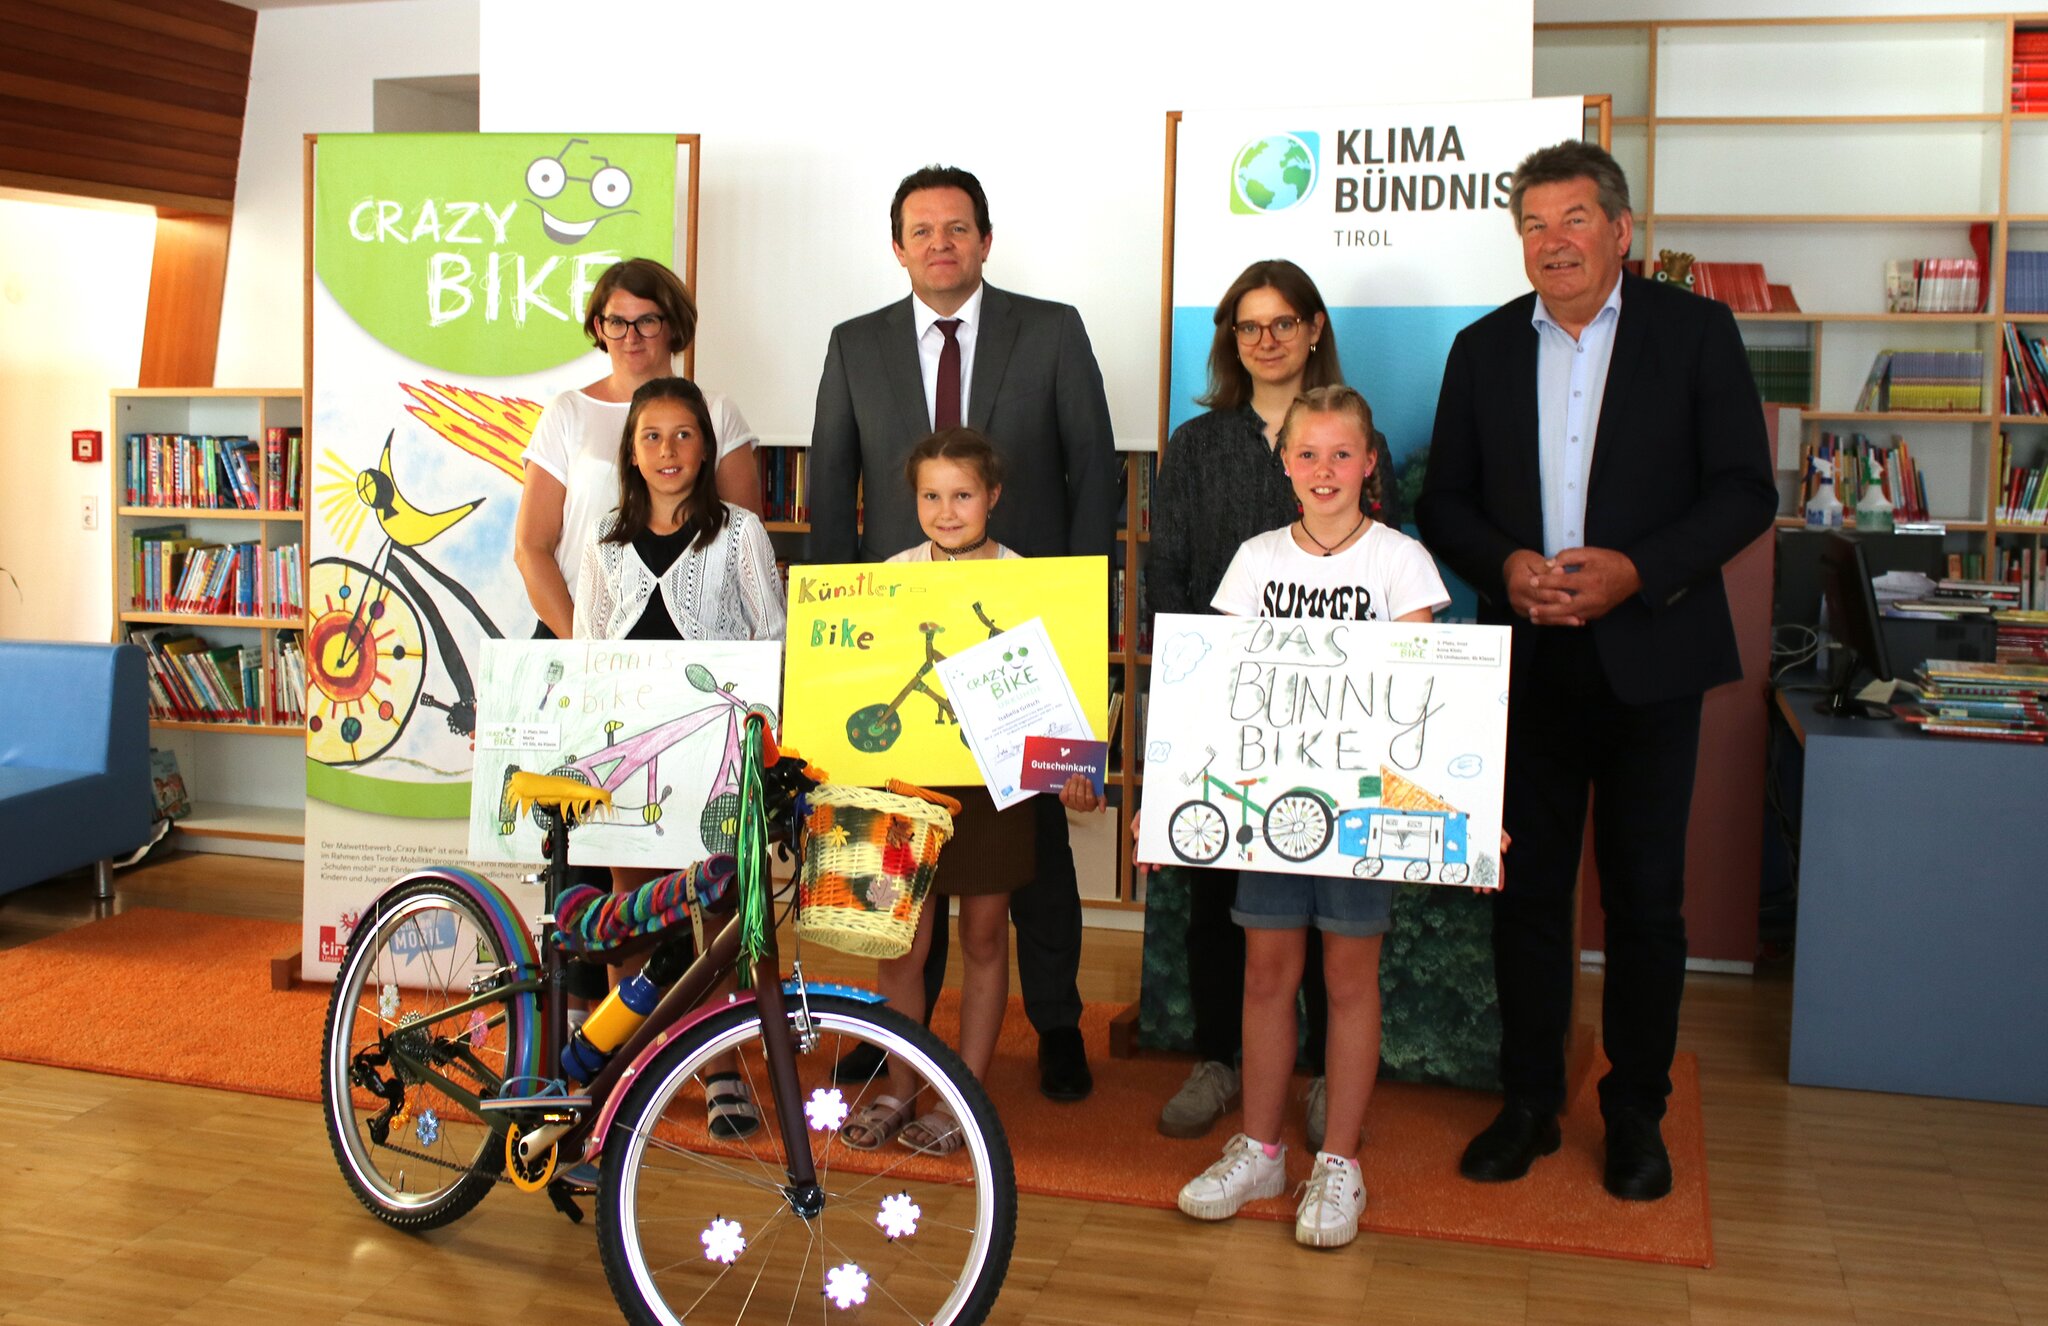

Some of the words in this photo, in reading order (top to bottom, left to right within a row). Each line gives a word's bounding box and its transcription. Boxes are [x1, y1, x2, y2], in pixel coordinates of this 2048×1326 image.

[1337, 125, 1465, 165] KLIMA
[1335, 167, 1514, 213] BÜNDNIS
[348, 197, 518, 246] CRAZY
[1333, 229, 1394, 247] TIROL
[1260, 580, 1371, 621] SUMMER
[810, 618, 875, 650] Bike
[1244, 619, 1349, 667] DAS
[584, 642, 675, 675] Tennis
[1400, 648, 1426, 659] BIKE
[966, 665, 1005, 690] CRAZY
[990, 665, 1039, 700] BIKE
[582, 680, 653, 713] bike
[1241, 725, 1368, 771] BIKE
[1031, 759, 1097, 774] Gutscheinkarte
[321, 841, 334, 849] Der
[336, 842, 392, 852] Malwettbewerb
[448, 847, 464, 855] eine
[331, 852, 360, 860] Rahmen
[376, 854, 398, 862] Tiroler
[400, 855, 475, 868] Mobilitätsprogramms
[320, 873, 347, 881] Kindern
[395, 927, 445, 951] MOBIL
[1326, 1156, 1344, 1168] FILA
